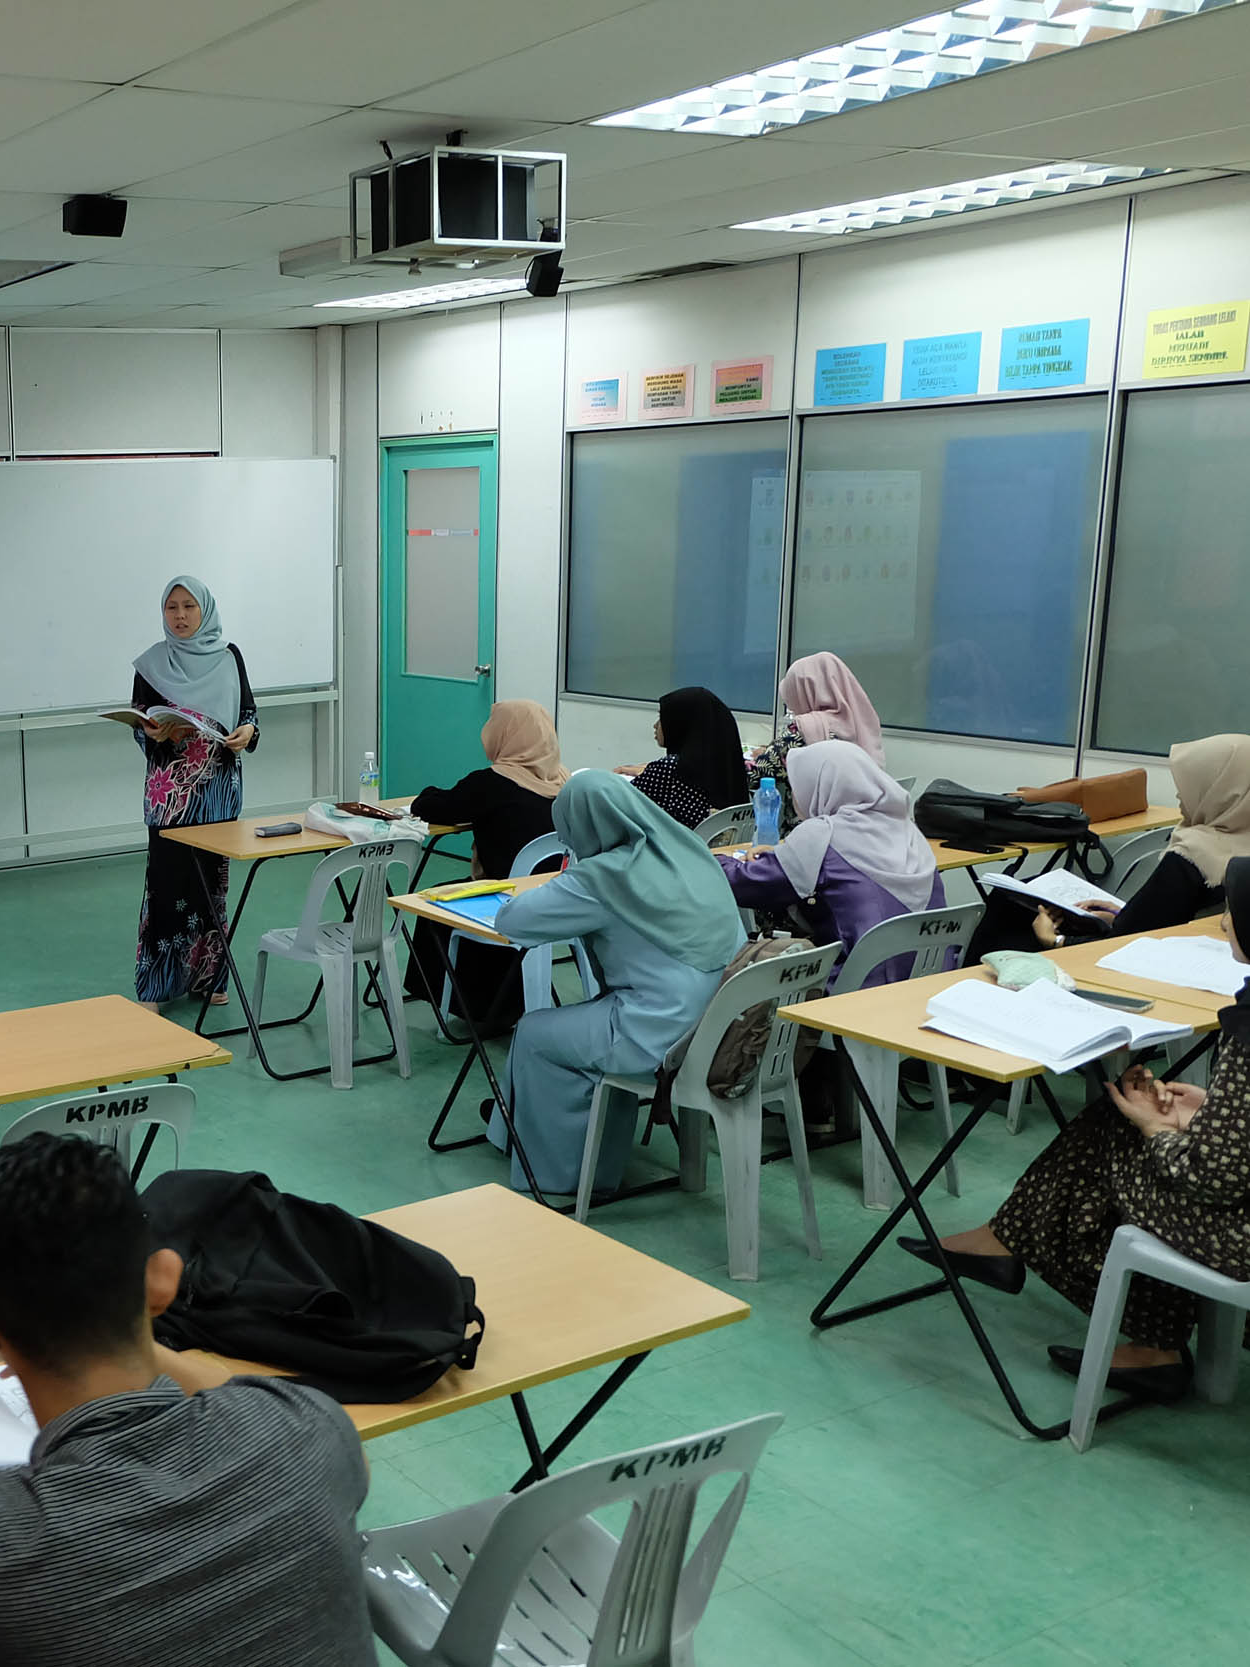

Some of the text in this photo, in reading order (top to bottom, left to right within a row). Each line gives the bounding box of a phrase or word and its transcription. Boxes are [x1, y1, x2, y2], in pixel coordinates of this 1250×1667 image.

[1175, 330, 1204, 341] IALAH
[1168, 341, 1210, 352] MENJADI
[731, 810, 755, 821] KPM
[358, 844, 395, 858] KPMB
[65, 1096, 149, 1123] KPMB
[609, 1436, 727, 1481] KPMB
